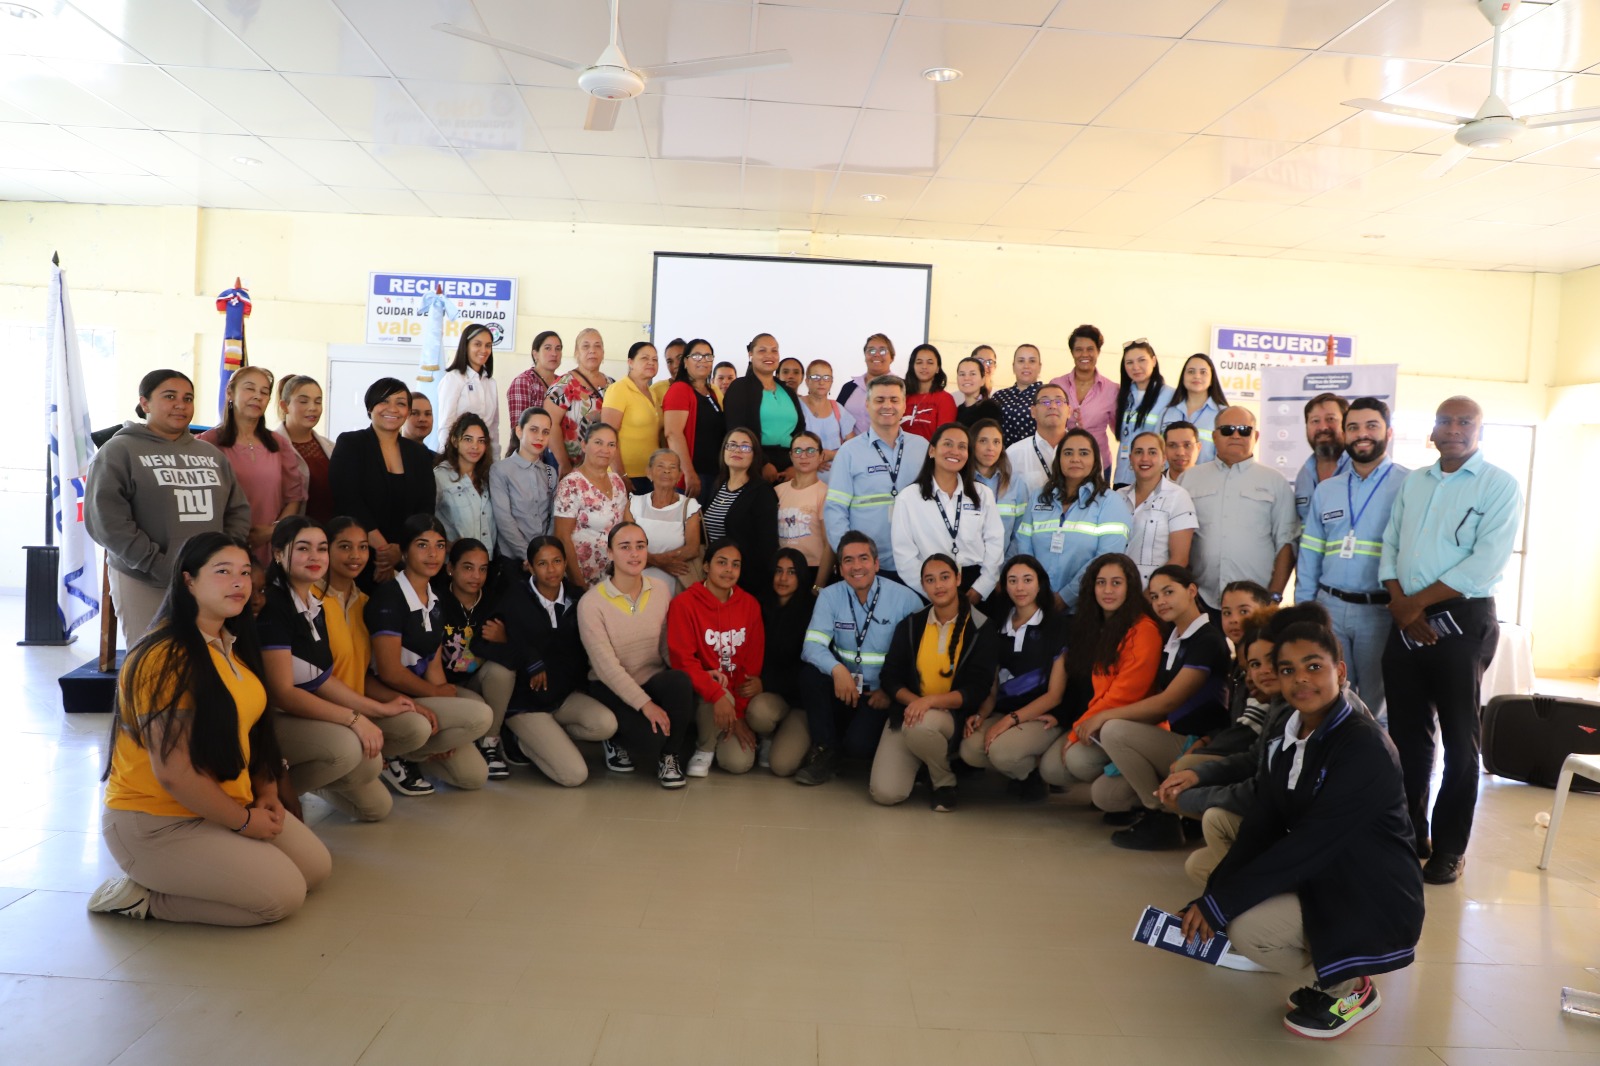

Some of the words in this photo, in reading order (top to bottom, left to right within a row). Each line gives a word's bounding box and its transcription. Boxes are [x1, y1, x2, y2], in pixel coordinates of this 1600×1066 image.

[376, 306, 414, 317] CUIDAR
[457, 309, 506, 320] GURIDAD
[377, 318, 422, 336] vale
[1220, 360, 1257, 371] CUIDAR
[1220, 374, 1262, 391] vale
[138, 454, 177, 467] NEW
[179, 453, 220, 468] YORK
[160, 470, 218, 485] GIANTS
